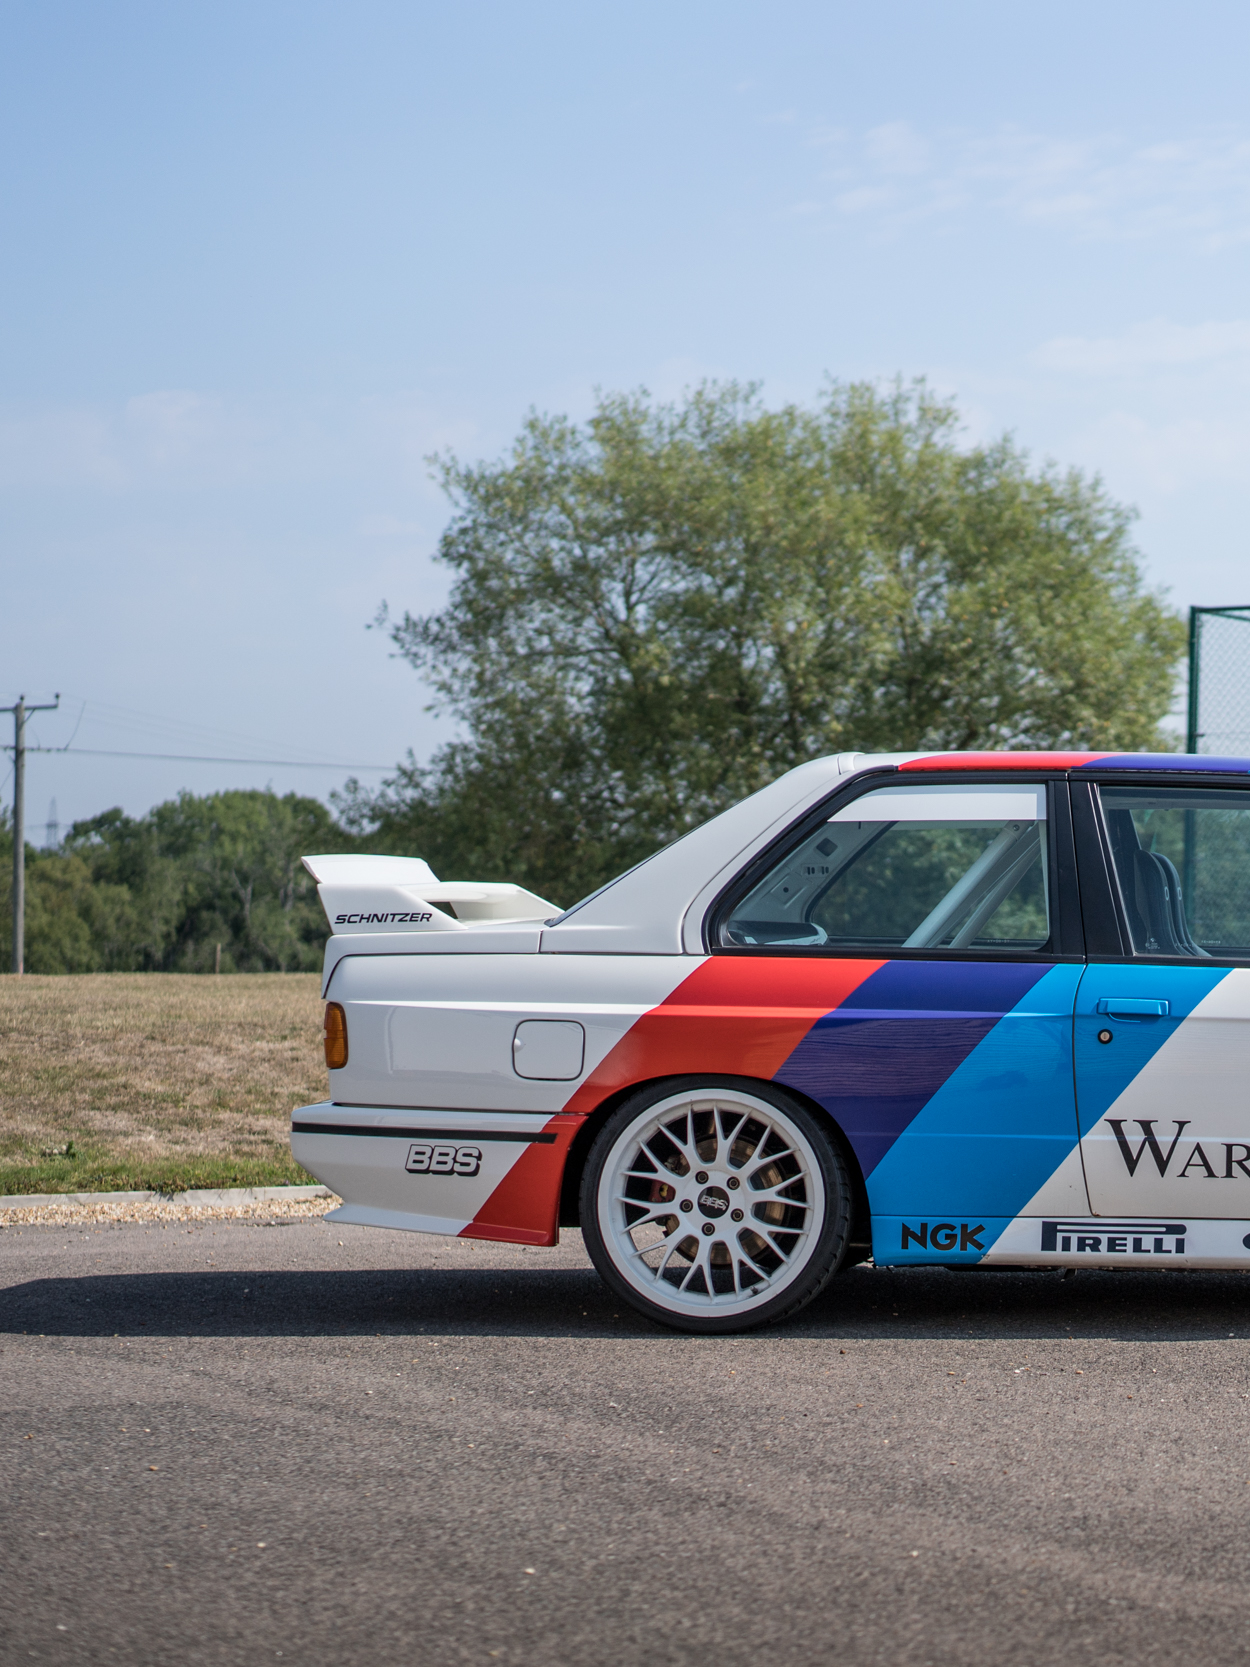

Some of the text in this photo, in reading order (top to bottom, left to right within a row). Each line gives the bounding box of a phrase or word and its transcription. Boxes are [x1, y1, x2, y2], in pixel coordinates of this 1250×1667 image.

[334, 912, 433, 924] SCHNITZER
[405, 1143, 483, 1177] BBS
[901, 1222, 986, 1251] NGK
[1041, 1220, 1187, 1254] PIRELLI
